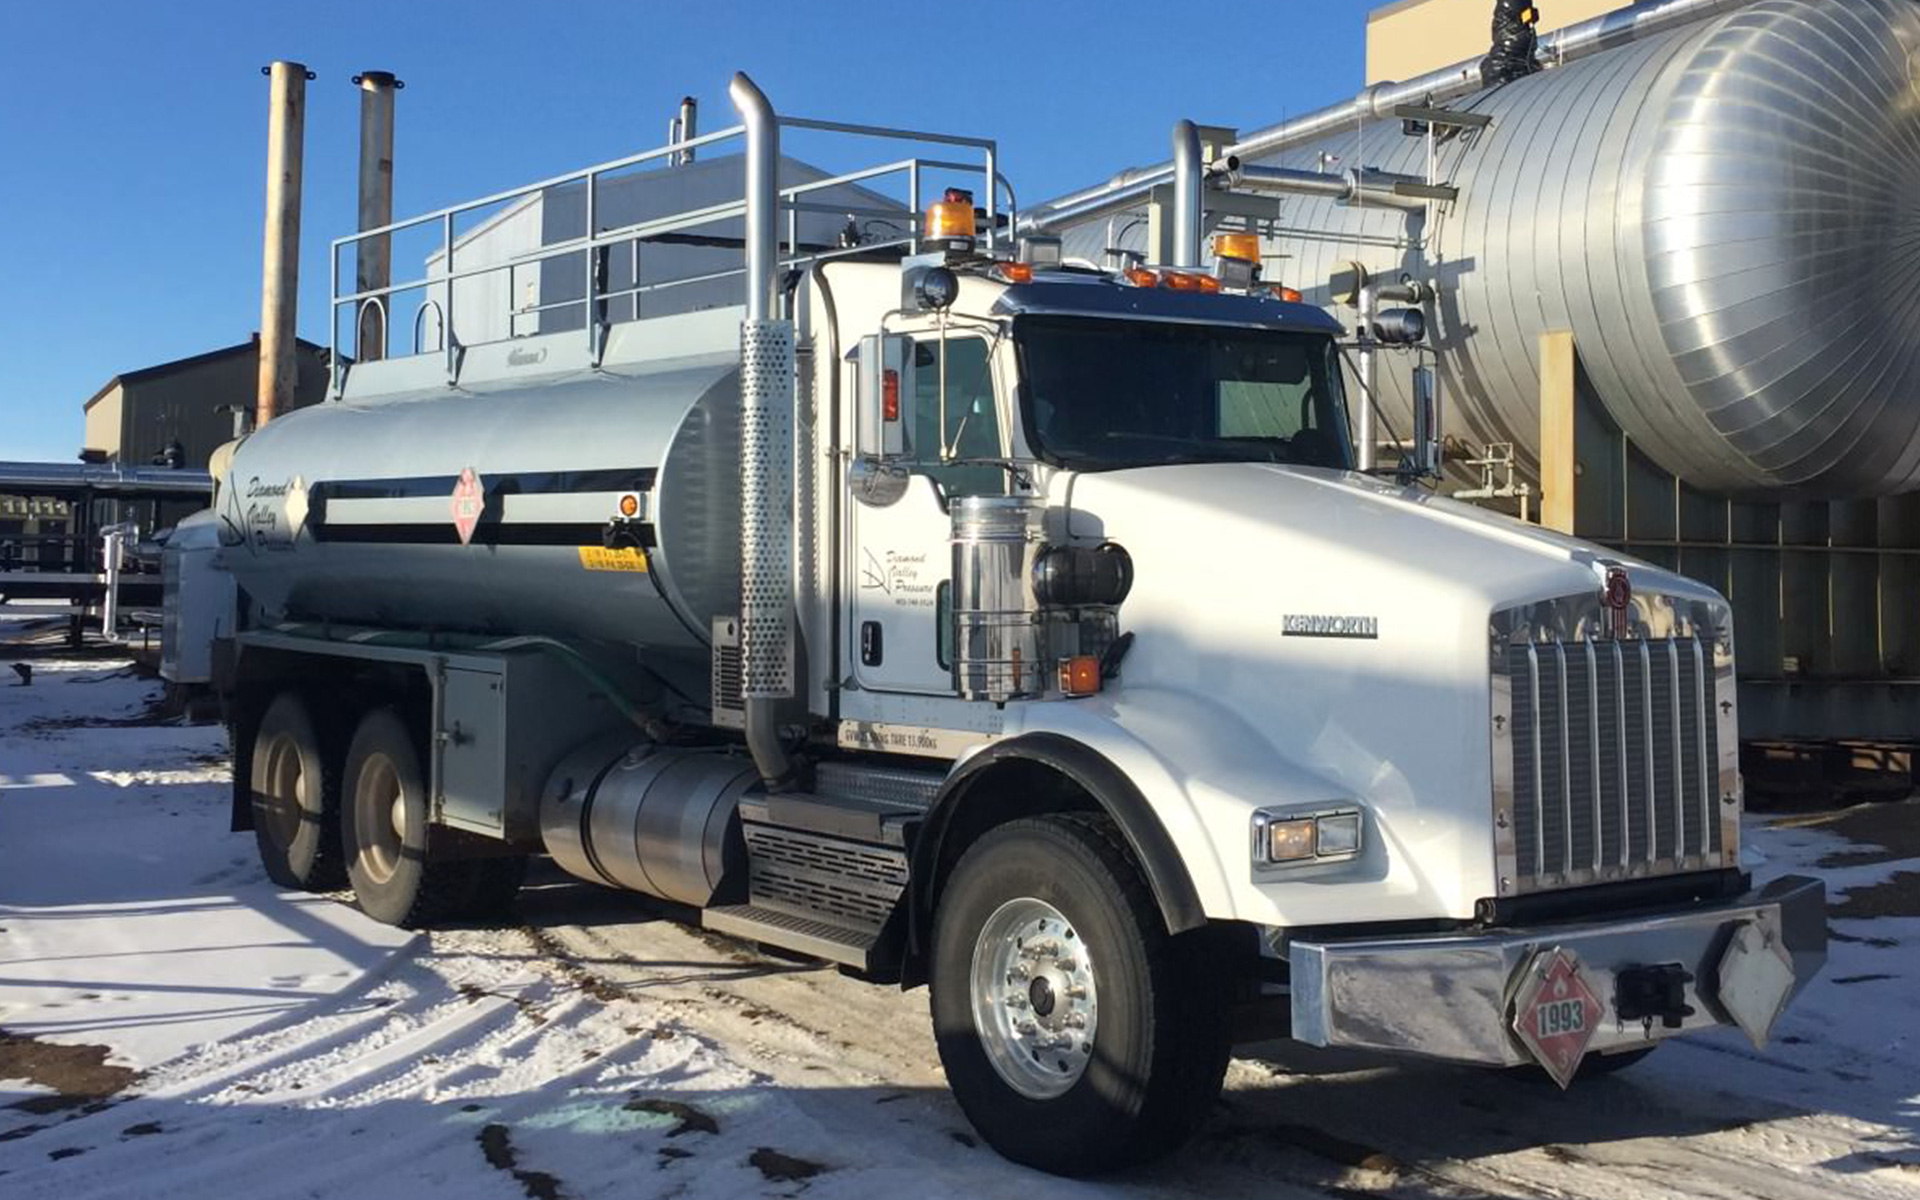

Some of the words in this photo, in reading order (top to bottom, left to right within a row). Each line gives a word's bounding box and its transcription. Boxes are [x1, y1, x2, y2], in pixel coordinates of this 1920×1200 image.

[887, 550, 927, 563] Diamond
[896, 579, 934, 592] Pressure
[1282, 614, 1378, 634] KENWORTH
[1538, 1001, 1583, 1035] 1993
[1559, 1049, 1569, 1067] 3
